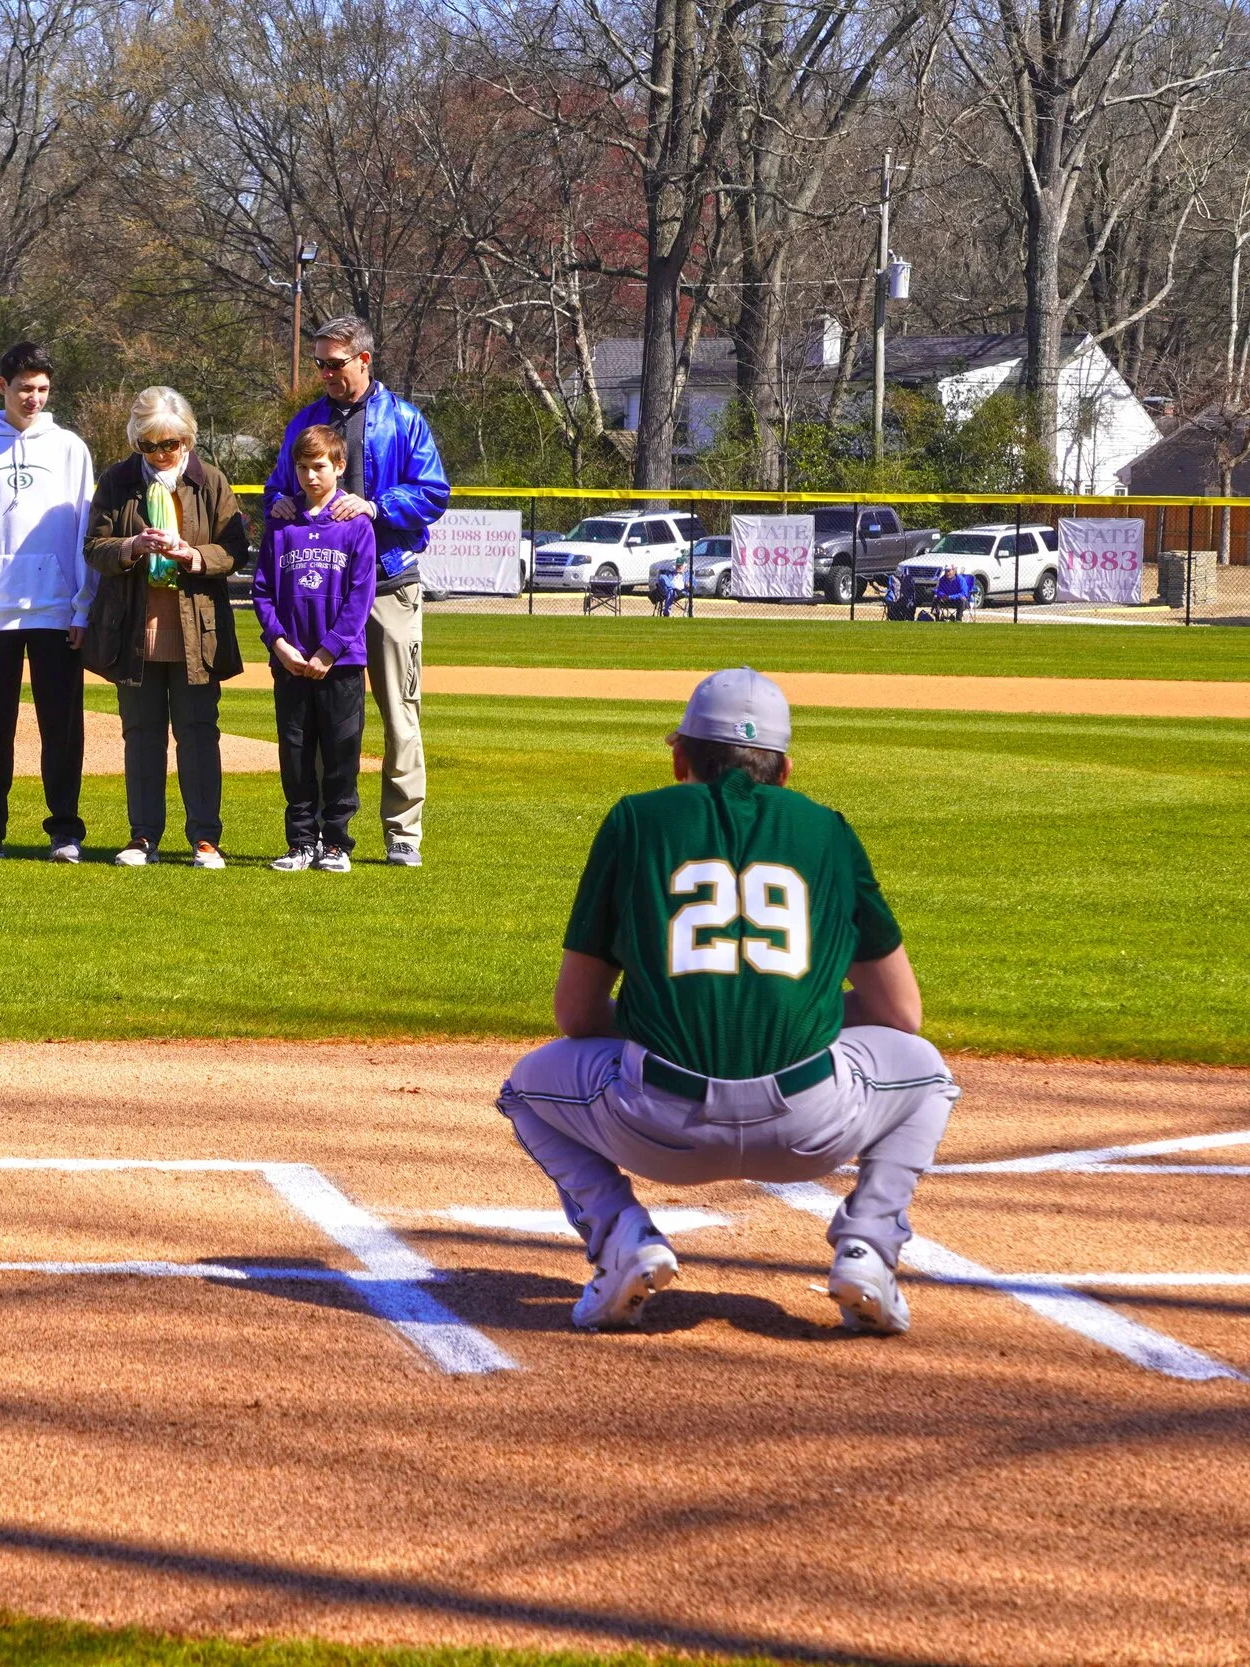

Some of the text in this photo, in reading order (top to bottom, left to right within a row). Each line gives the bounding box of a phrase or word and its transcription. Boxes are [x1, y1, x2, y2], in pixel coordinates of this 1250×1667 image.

[451, 530, 481, 541] 1988
[486, 530, 516, 542] 1990
[279, 548, 348, 568] WILDCATS
[450, 545, 480, 556] 2013
[485, 546, 516, 557] 2016
[738, 546, 809, 567] 1982
[1067, 550, 1138, 571] 1983
[668, 858, 811, 981] 29
